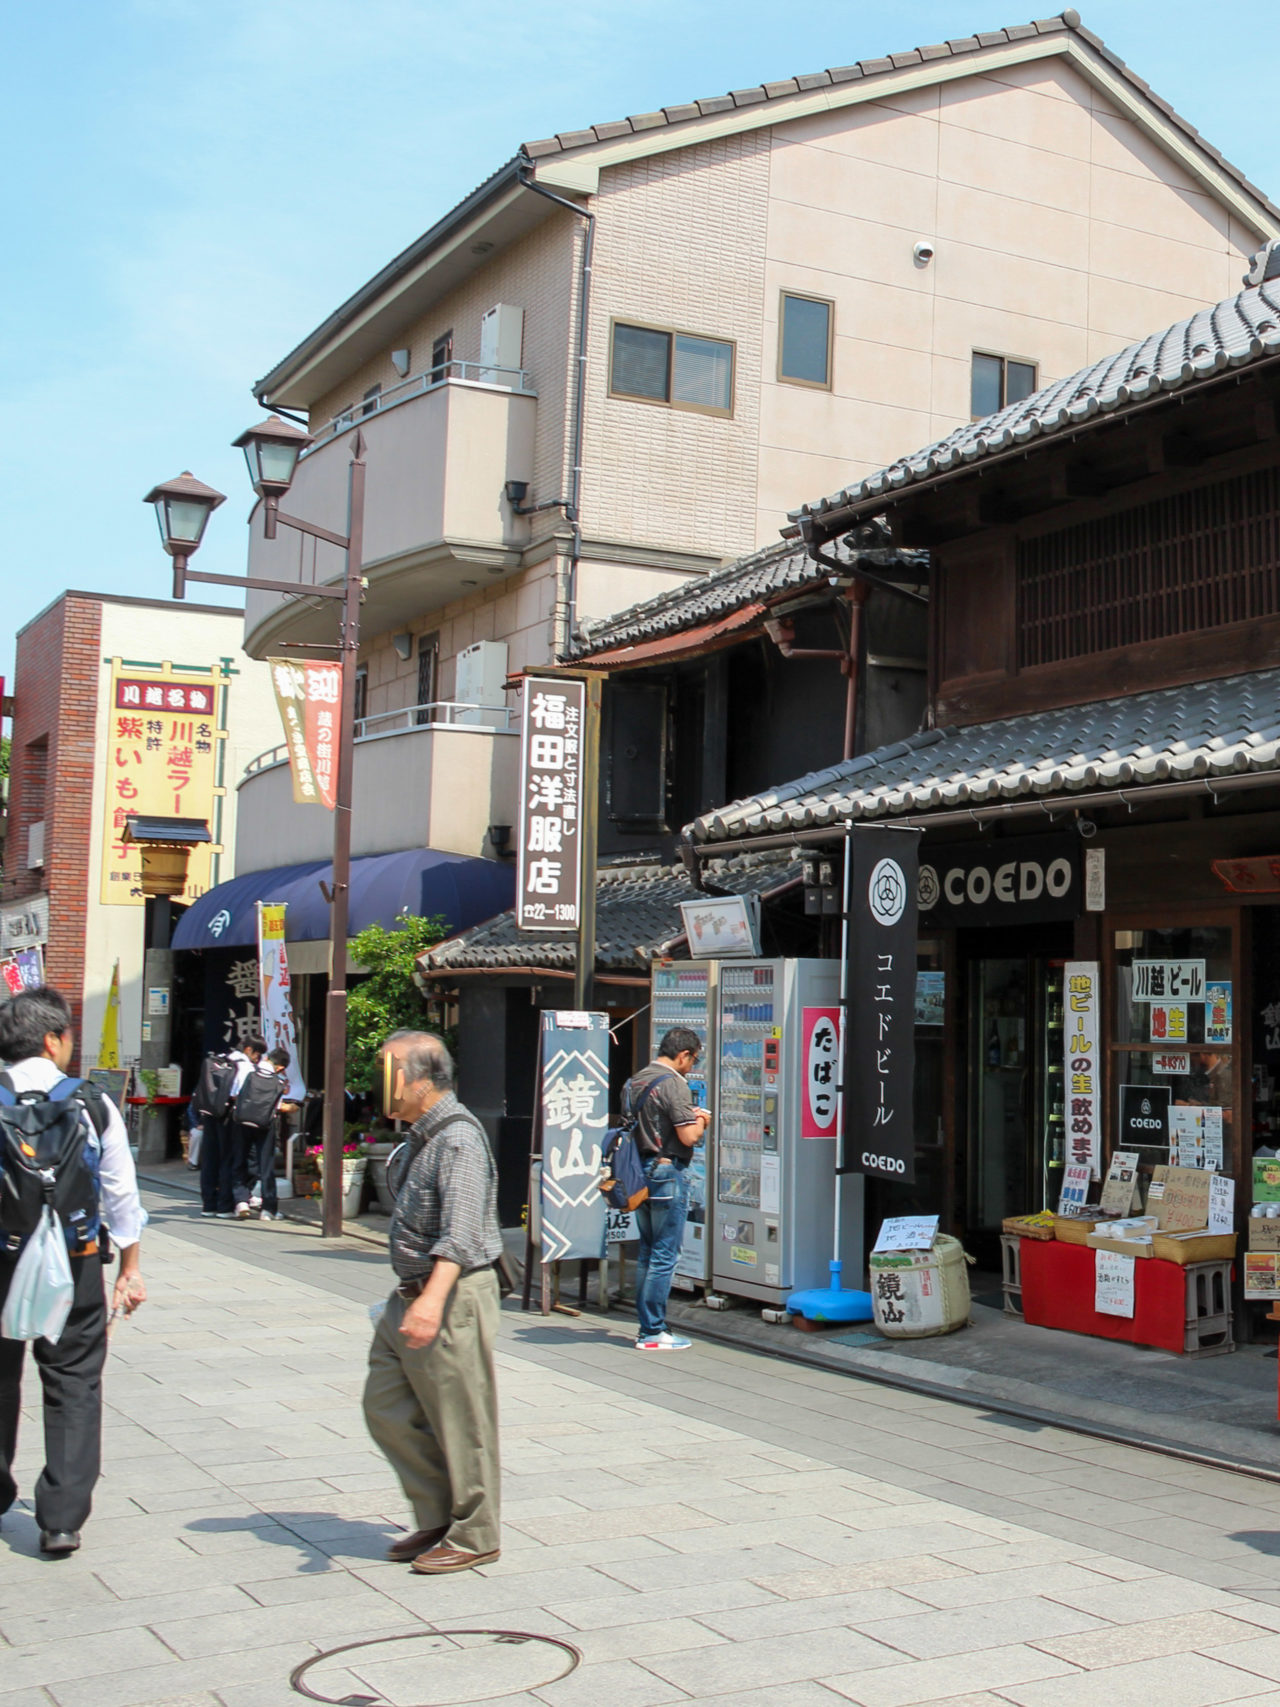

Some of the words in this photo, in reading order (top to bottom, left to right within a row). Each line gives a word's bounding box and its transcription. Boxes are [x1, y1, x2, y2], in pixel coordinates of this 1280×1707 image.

[122, 684, 208, 710] 川越名物
[146, 720, 163, 751] 特許
[166, 720, 194, 814] 川越ラー
[527, 692, 567, 894] 福田洋服店
[562, 706, 580, 836] 注文服と寸法直し
[944, 857, 1073, 905] COEDO
[1135, 964, 1202, 996] 川越ビール
[812, 1027, 839, 1116] たばこ
[873, 953, 895, 1128] コエドビール
[1069, 974, 1094, 1166] 地ビールの生飲めます
[543, 1073, 610, 1181] 鏡山
[1130, 1117, 1162, 1129] COEDO
[861, 1151, 906, 1174] COEDO
[876, 1272, 906, 1324] 鏡山
